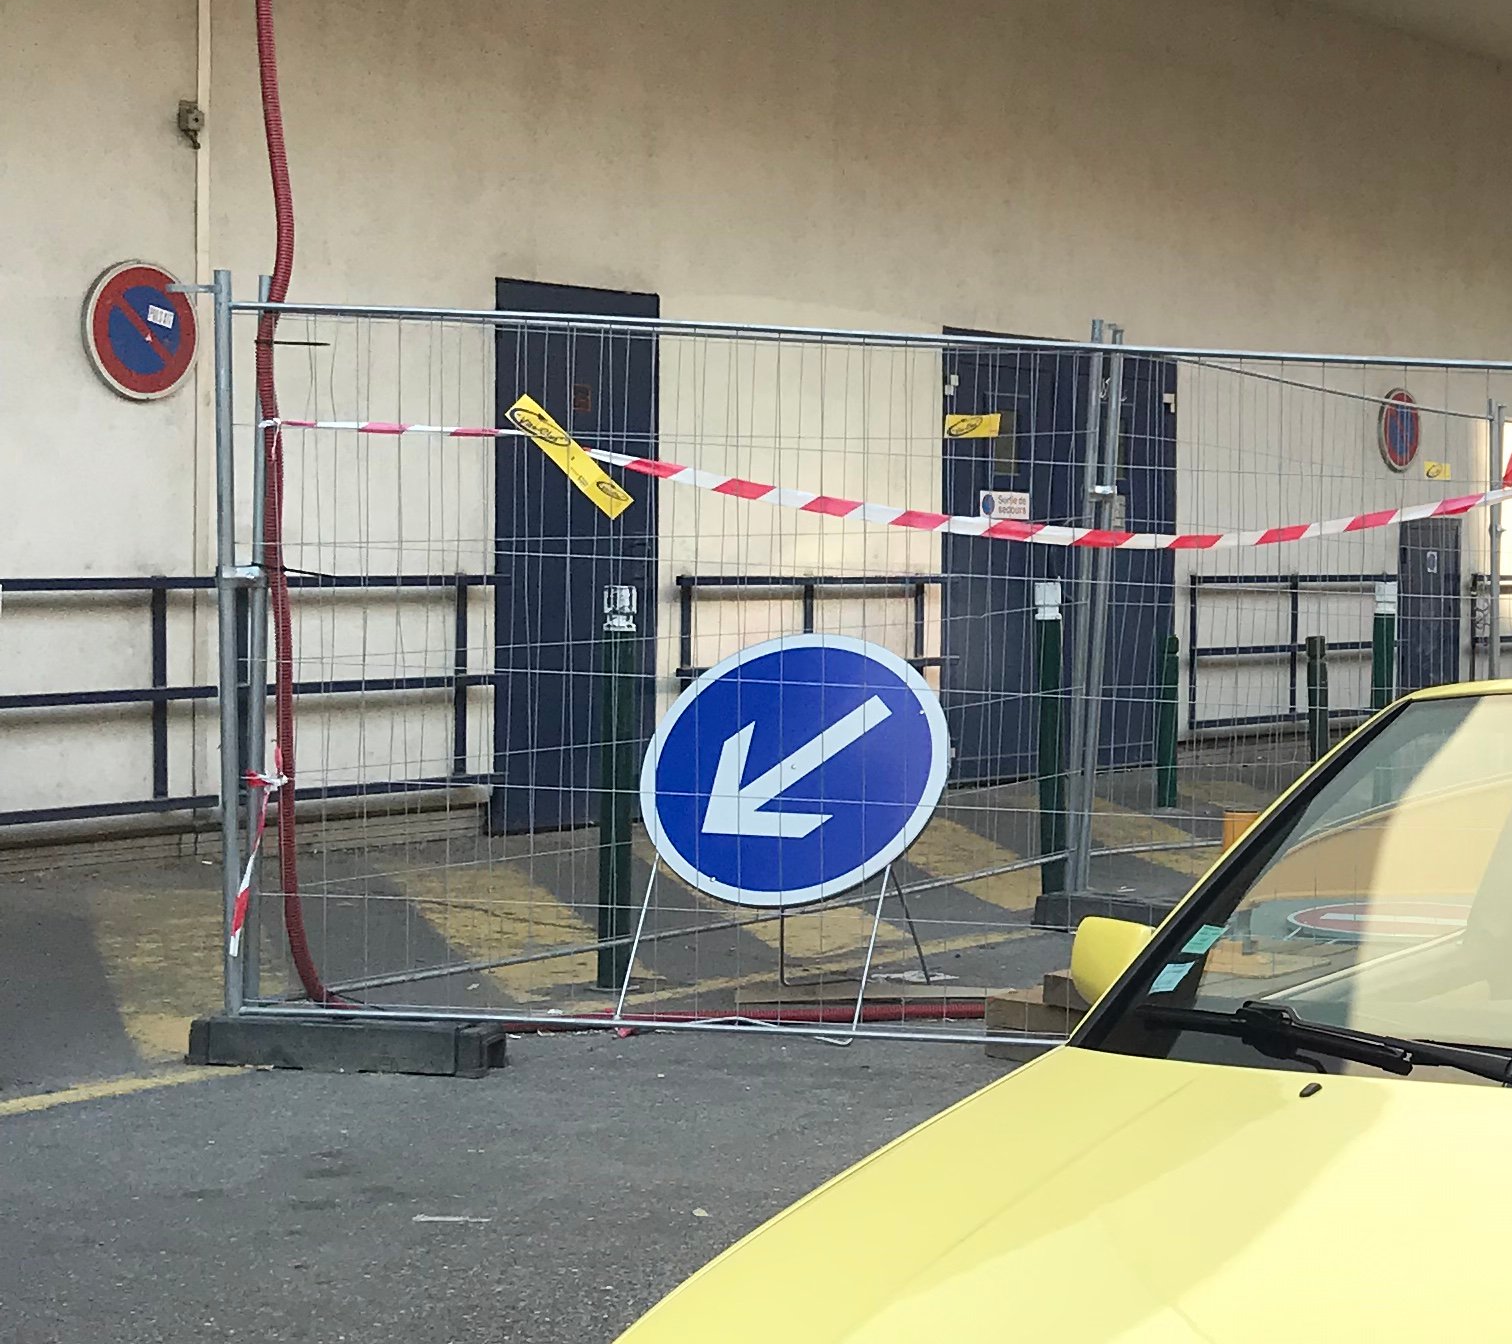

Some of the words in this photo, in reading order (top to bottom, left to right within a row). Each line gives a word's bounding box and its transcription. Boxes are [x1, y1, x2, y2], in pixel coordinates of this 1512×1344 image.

[998, 494, 1017, 505] Sortie
[1019, 495, 1027, 505] de
[998, 506, 1027, 515] secours
